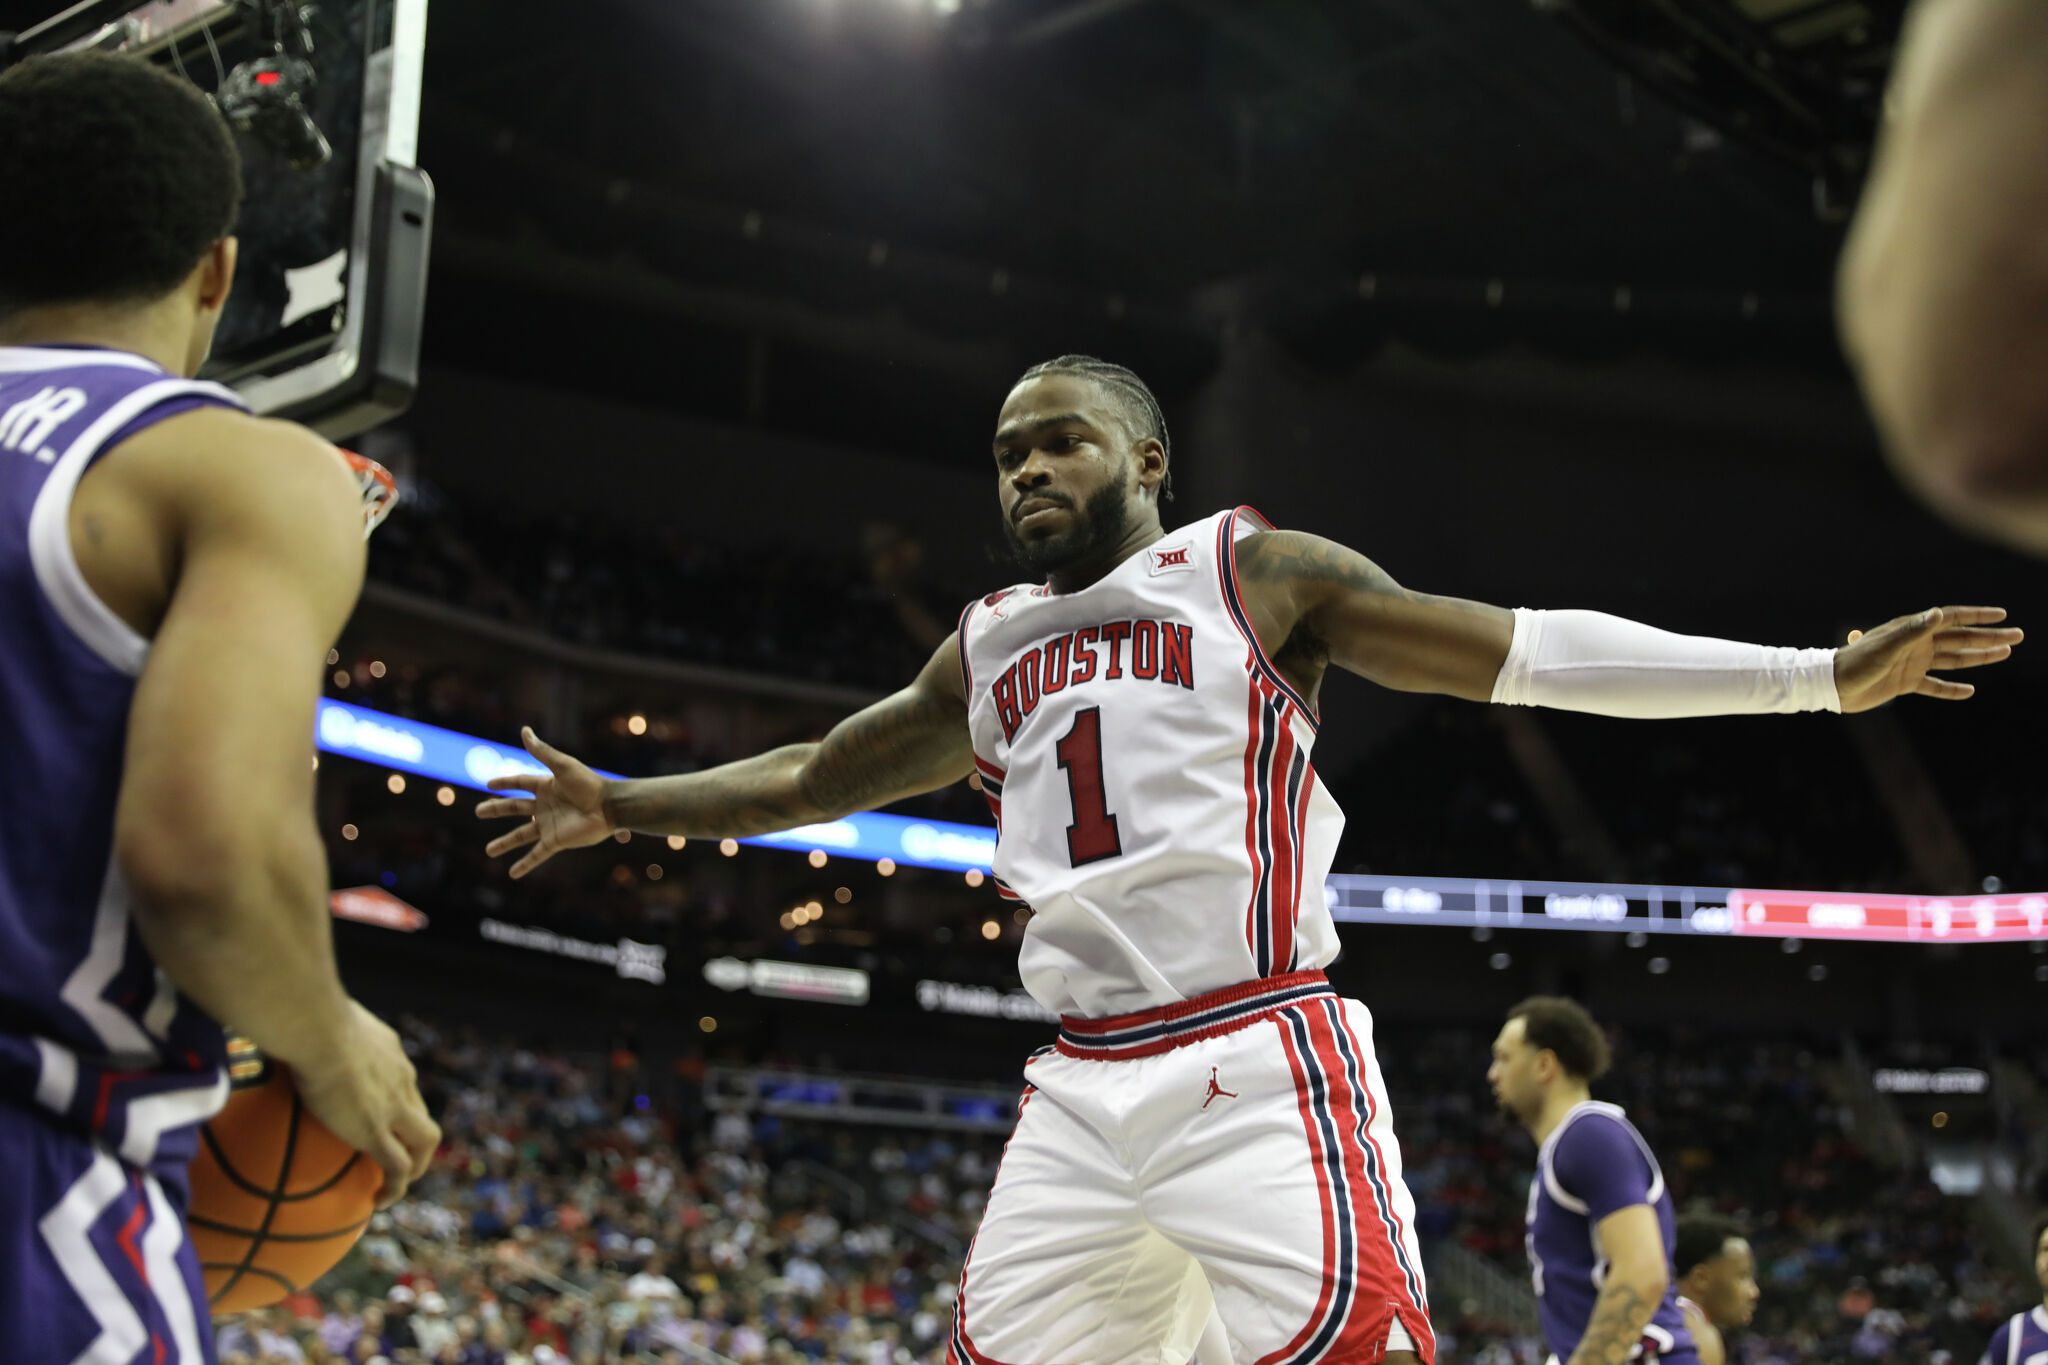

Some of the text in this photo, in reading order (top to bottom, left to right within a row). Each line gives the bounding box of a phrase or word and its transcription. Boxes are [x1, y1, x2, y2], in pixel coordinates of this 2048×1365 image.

[1156, 547, 1189, 568] XII
[992, 620, 1194, 748] HOUSTON
[1056, 705, 1122, 868] 1
